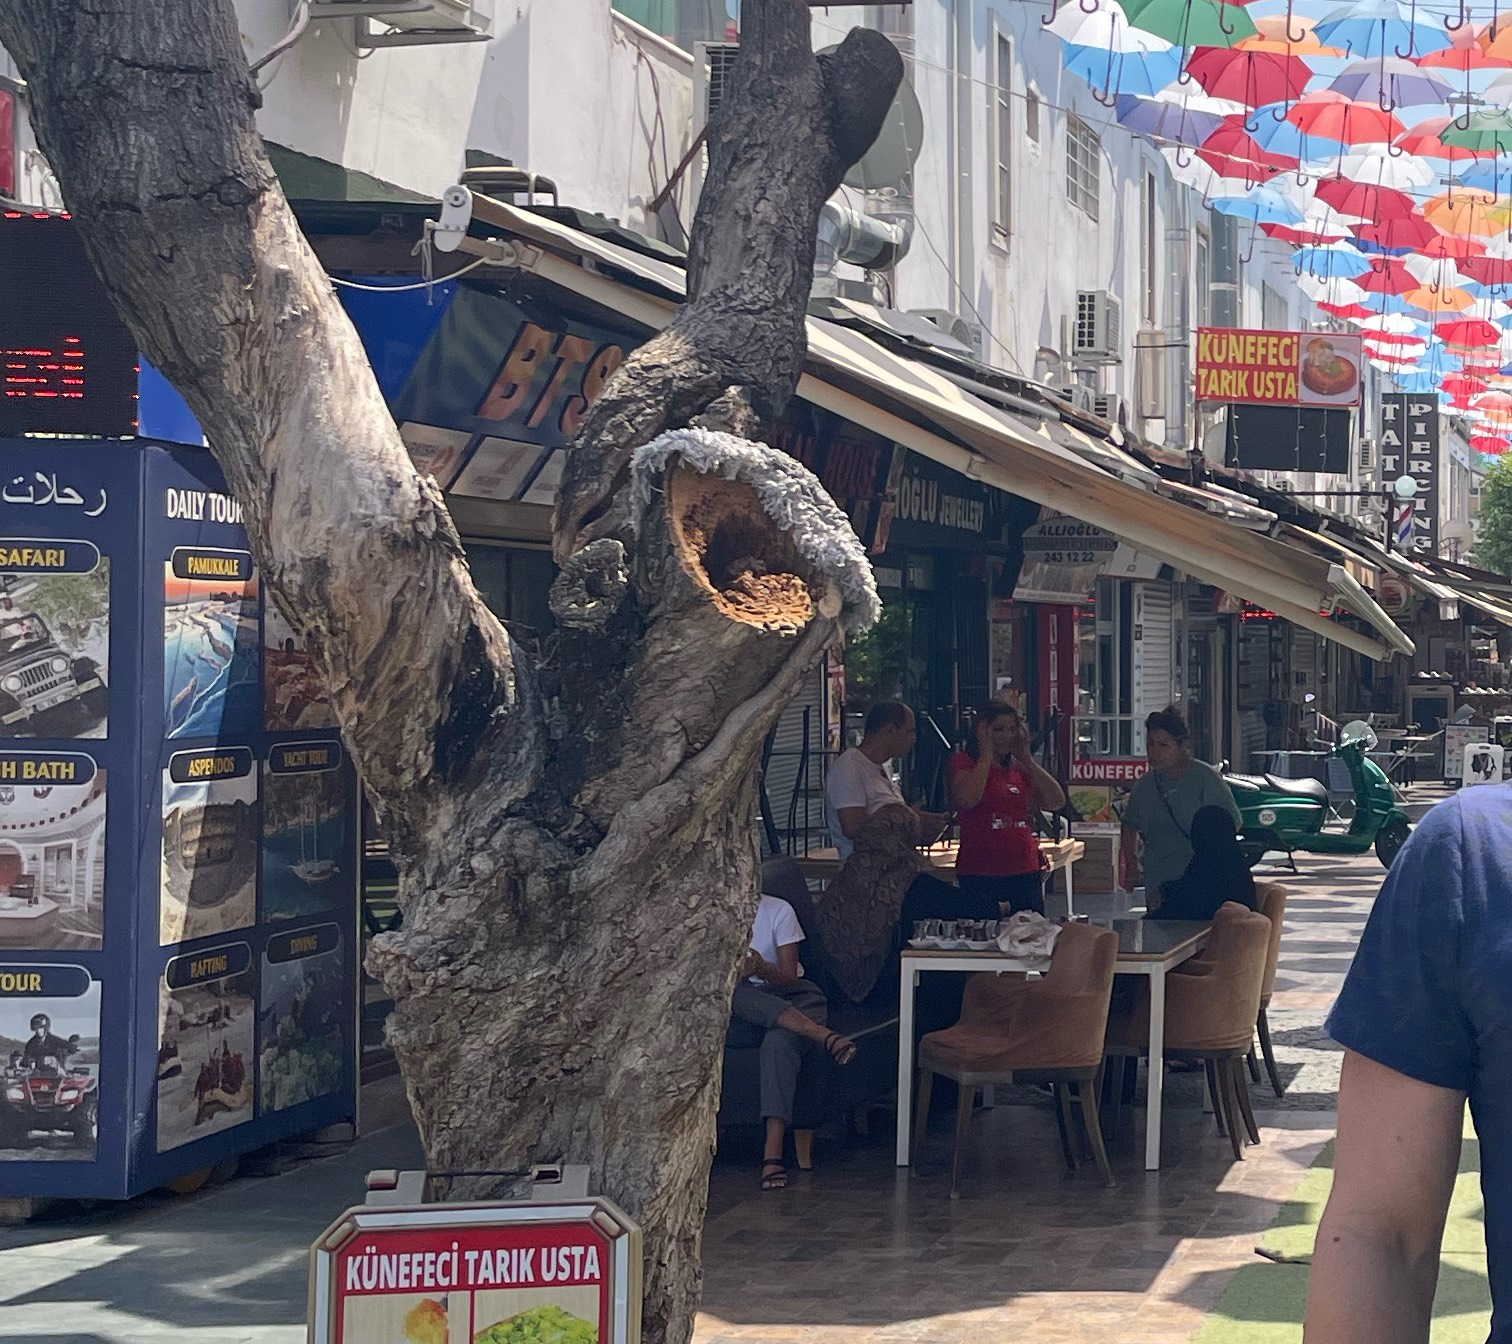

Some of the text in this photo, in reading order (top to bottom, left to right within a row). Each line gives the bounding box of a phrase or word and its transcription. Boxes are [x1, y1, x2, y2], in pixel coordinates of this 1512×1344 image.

[1198, 368, 1298, 399] TARIK USTA
[1408, 403, 1433, 549] PIERCING
[2, 472, 107, 517] رحلات
[167, 488, 204, 521] DAILY
[187, 556, 239, 576] PAMUKKALE
[1067, 552, 1079, 563] 12
[1082, 552, 1094, 562] 22
[23, 761, 75, 780] BATH
[188, 757, 235, 777] ASPENDOS
[190, 955, 228, 978] RAFTING
[346, 1242, 601, 1291] KÜNEFECİ TARIK USTA
